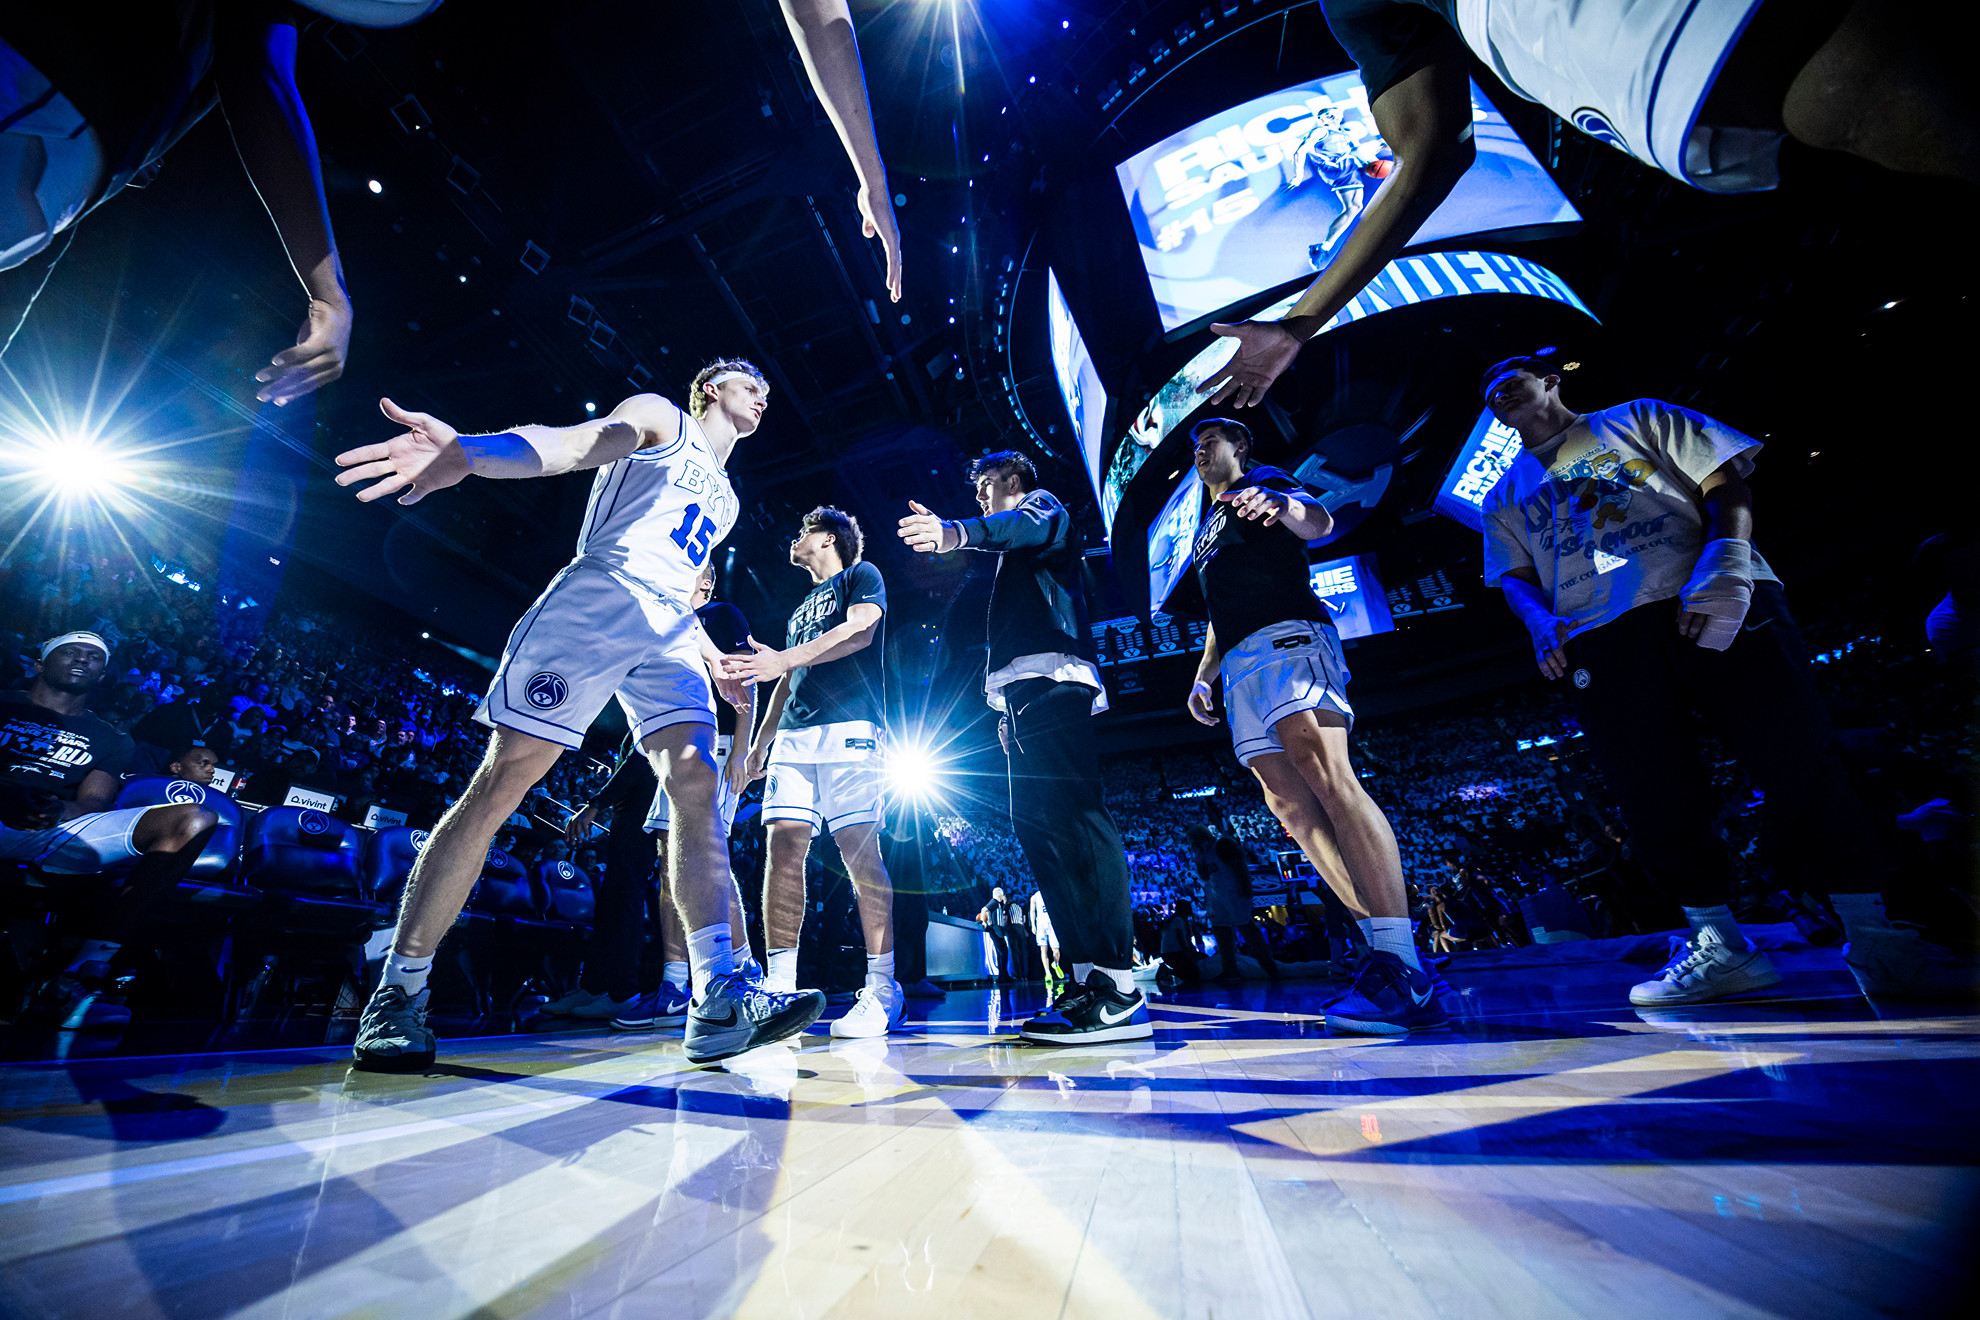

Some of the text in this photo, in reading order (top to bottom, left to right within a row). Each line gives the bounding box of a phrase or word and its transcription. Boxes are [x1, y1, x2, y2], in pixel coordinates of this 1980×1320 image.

[1156, 194, 1261, 253] #15
[1452, 417, 1516, 501] RICHIE
[670, 503, 717, 567] 15
[1559, 577, 1579, 591] THE
[54, 735, 91, 750] MARK
